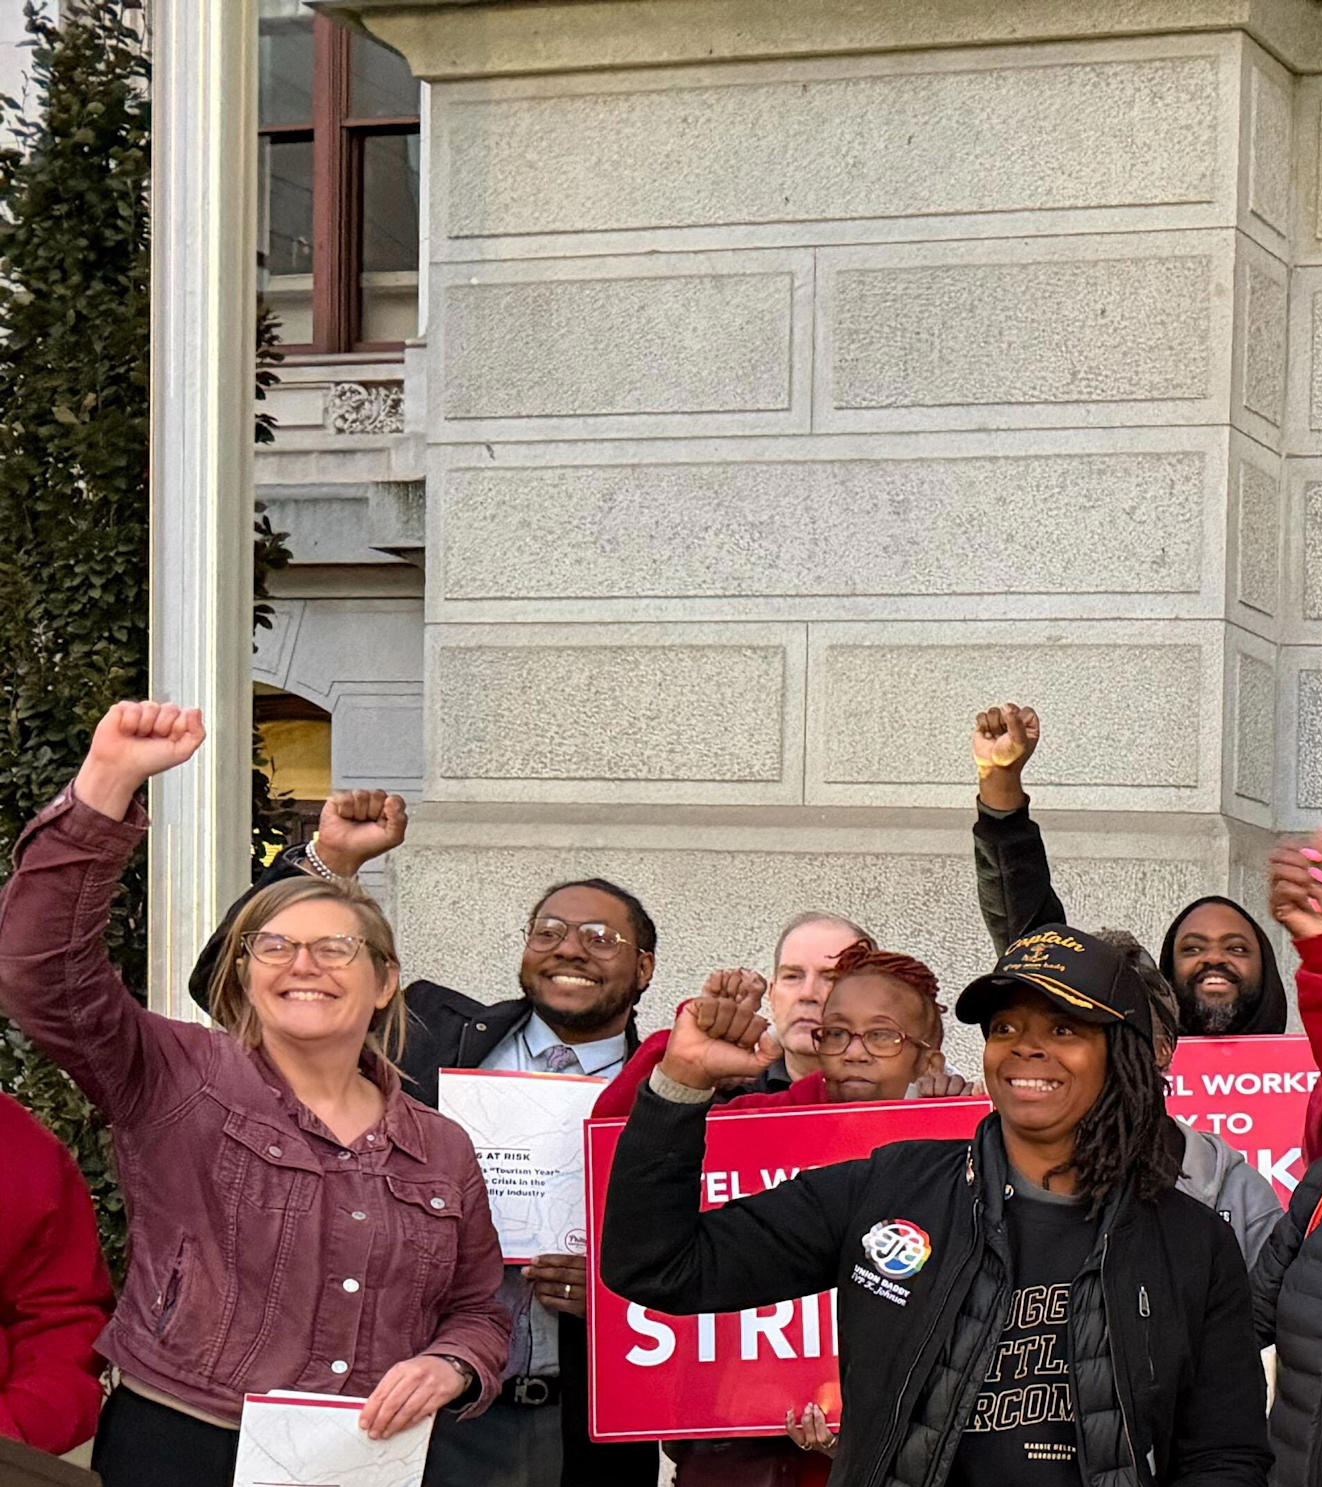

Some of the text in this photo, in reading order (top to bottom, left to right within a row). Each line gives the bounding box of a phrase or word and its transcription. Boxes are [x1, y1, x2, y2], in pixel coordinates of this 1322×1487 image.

[1206, 1113, 1253, 1135] TO
[486, 1152, 501, 1160] AT
[504, 1153, 530, 1161] RISK
